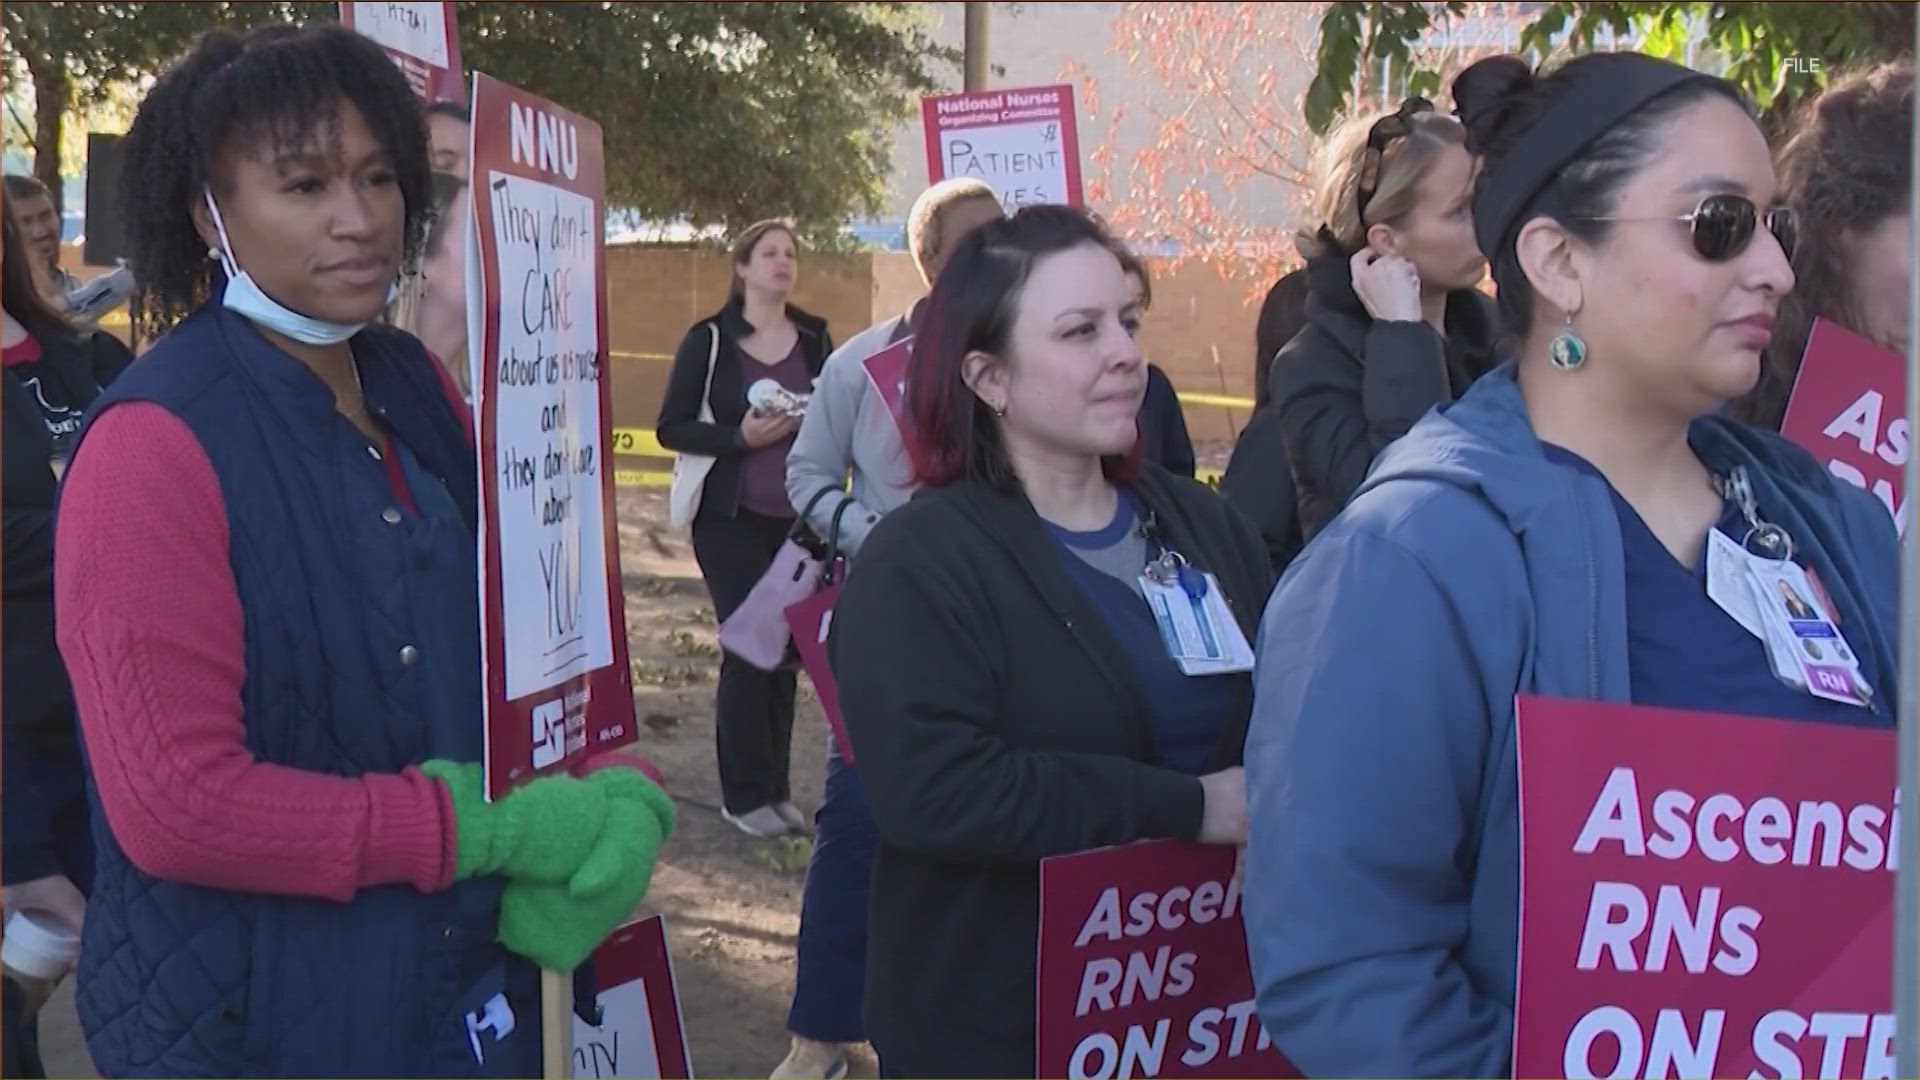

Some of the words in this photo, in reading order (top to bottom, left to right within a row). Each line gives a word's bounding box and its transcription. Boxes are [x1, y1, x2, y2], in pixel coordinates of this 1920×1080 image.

[937, 95, 1003, 114] National
[1006, 92, 1059, 107] Nurses
[938, 112, 1000, 126] Organizing
[511, 101, 578, 180] NNU
[950, 139, 1059, 175] PATIENT
[493, 177, 541, 275] They
[522, 267, 573, 335] CARE
[500, 339, 544, 386] about
[541, 389, 567, 432] and
[502, 446, 536, 516] they
[1817, 671, 1850, 693] RN
[1576, 881, 1764, 977] RNs
[1074, 945, 1198, 1018] RNs
[1067, 1018, 1172, 1080] ON
[1562, 1005, 1726, 1080] ON
